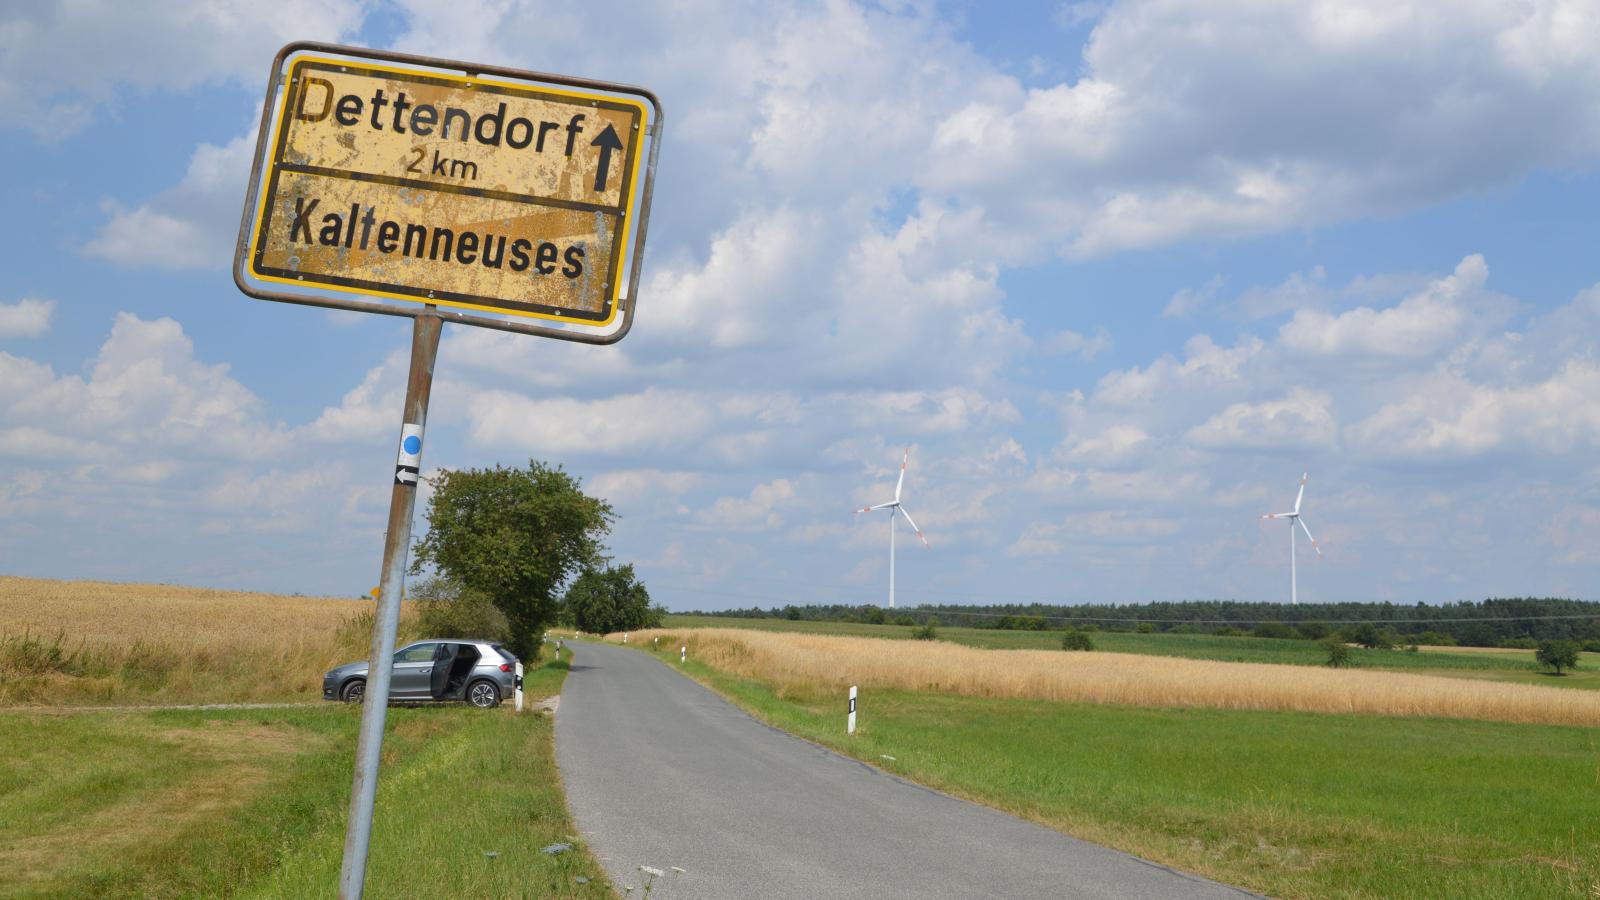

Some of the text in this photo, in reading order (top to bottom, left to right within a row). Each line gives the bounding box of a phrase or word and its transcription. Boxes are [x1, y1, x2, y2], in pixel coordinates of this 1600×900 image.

[295, 76, 585, 156] Dettendorf
[406, 147, 479, 181] 2 km
[289, 197, 586, 279] Kaltenneuses
